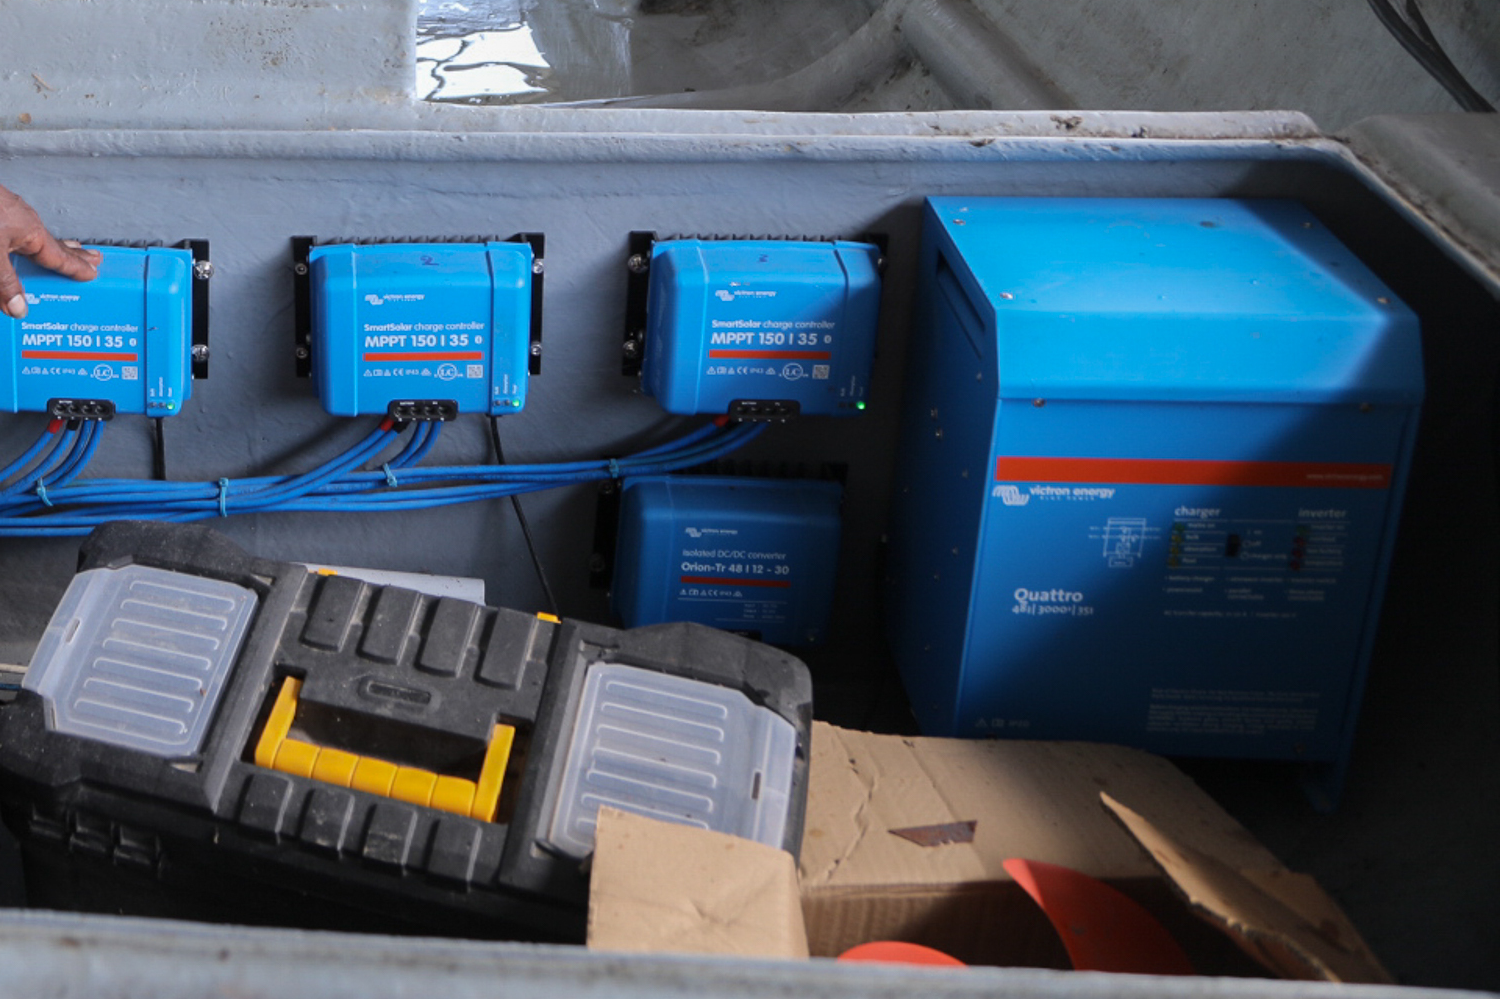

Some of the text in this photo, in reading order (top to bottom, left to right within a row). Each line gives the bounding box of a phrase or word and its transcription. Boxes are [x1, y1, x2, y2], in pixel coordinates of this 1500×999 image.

[21, 321, 138, 333] SmartSolar charge controller
[364, 321, 485, 332] SmartSolar charge controller
[712, 319, 835, 330] SmartSolar charge controller
[22, 334, 63, 346] MPPT
[67, 334, 92, 347] 150
[104, 336, 123, 348] 35
[364, 334, 407, 348] MPPT
[410, 334, 436, 347] 150
[450, 334, 468, 346] 35
[710, 332, 755, 344] MPPT
[758, 332, 785, 346] 150
[798, 333, 818, 346] 35
[1030, 486, 1116, 499] victron energy
[1174, 505, 1222, 519] charger
[1298, 507, 1347, 518] inverter
[717, 550, 746, 559] DC/DC
[748, 552, 786, 560] converter
[680, 561, 726, 573] Orion-Tr
[728, 563, 743, 574] 48
[752, 564, 764, 574] 12
[774, 565, 790, 576] 30
[1014, 588, 1084, 603] Quattro
